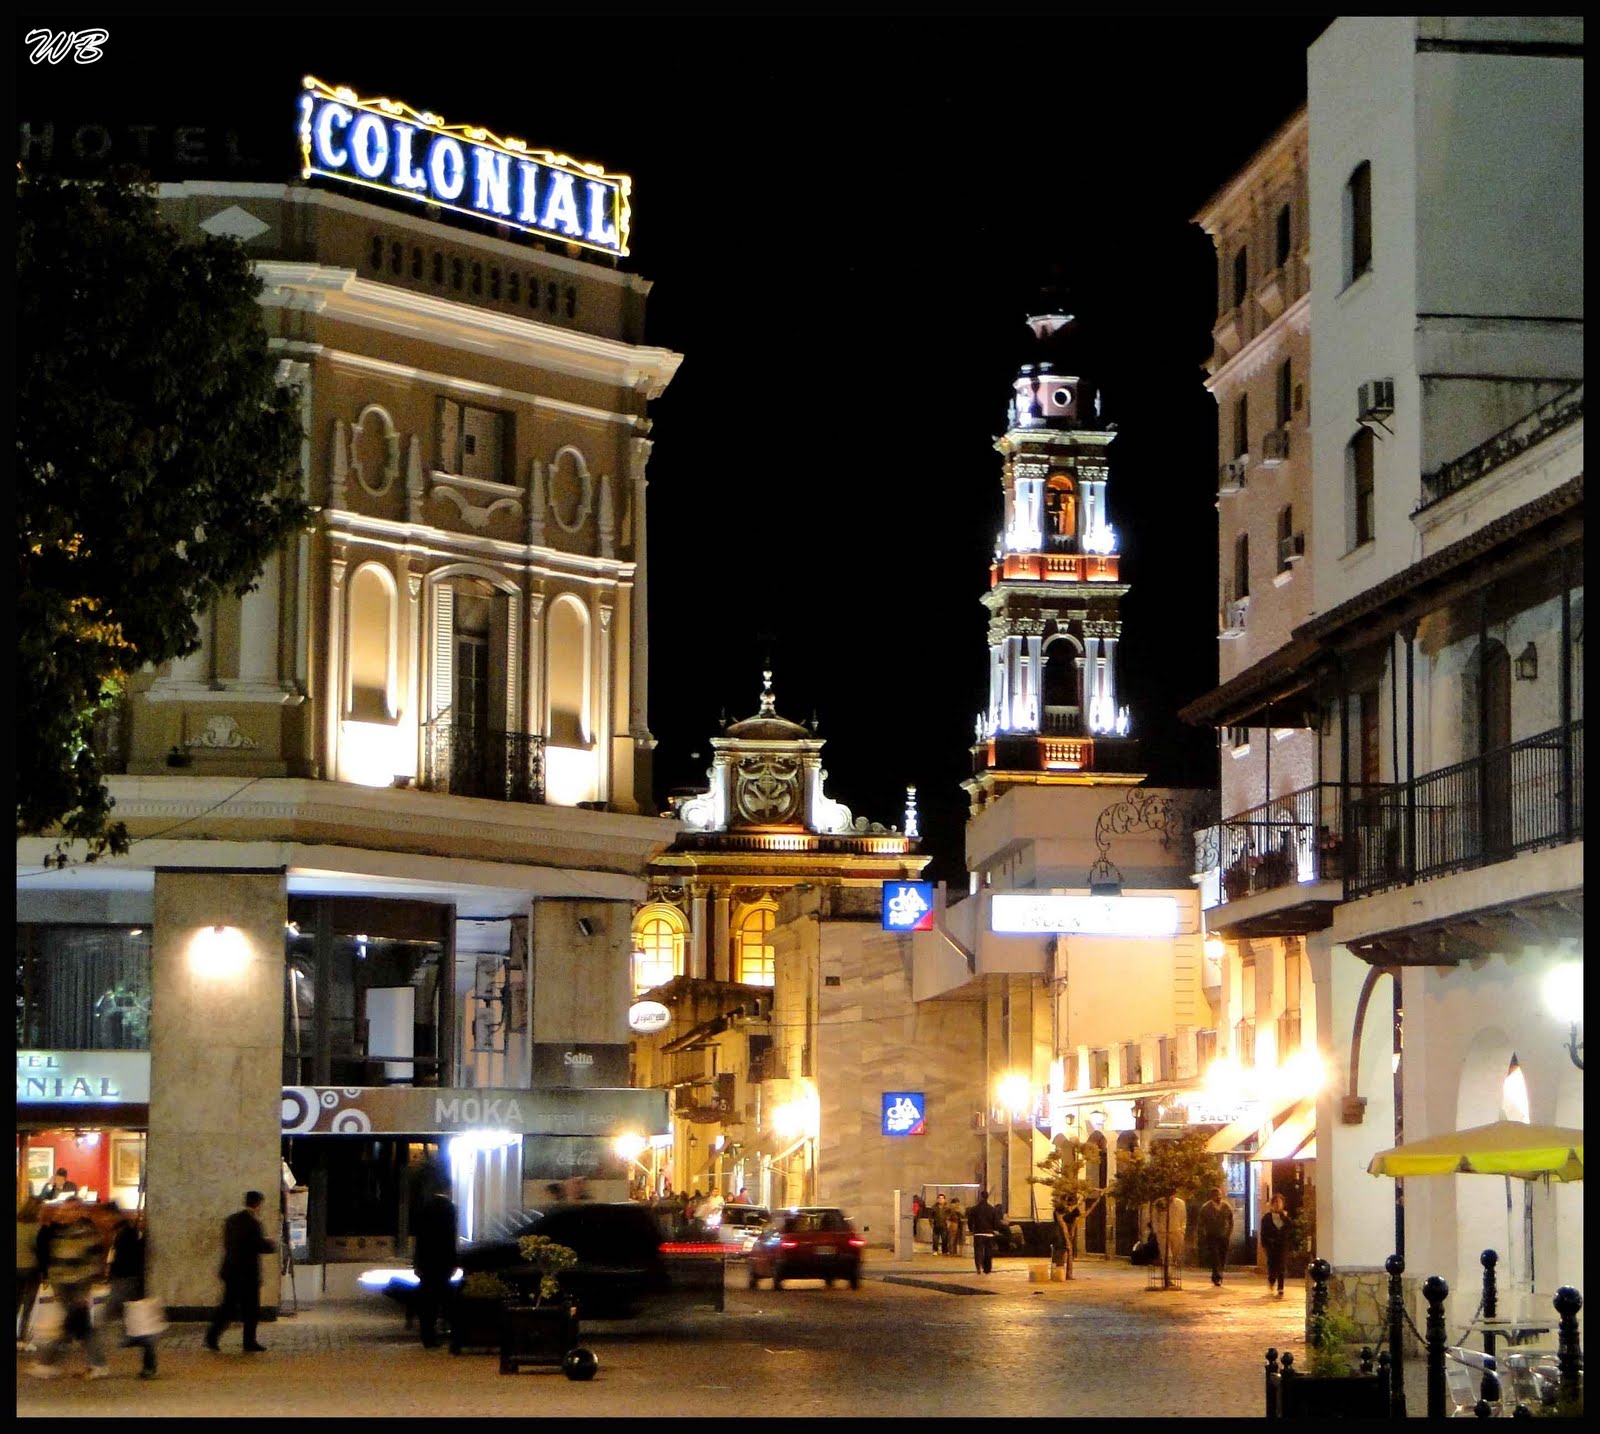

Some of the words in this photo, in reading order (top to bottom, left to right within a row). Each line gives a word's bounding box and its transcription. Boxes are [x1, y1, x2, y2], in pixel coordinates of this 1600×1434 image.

[314, 102, 618, 245] COLONIAL
[563, 1051, 594, 1066] Salta
[434, 1097, 524, 1124] MOKA
